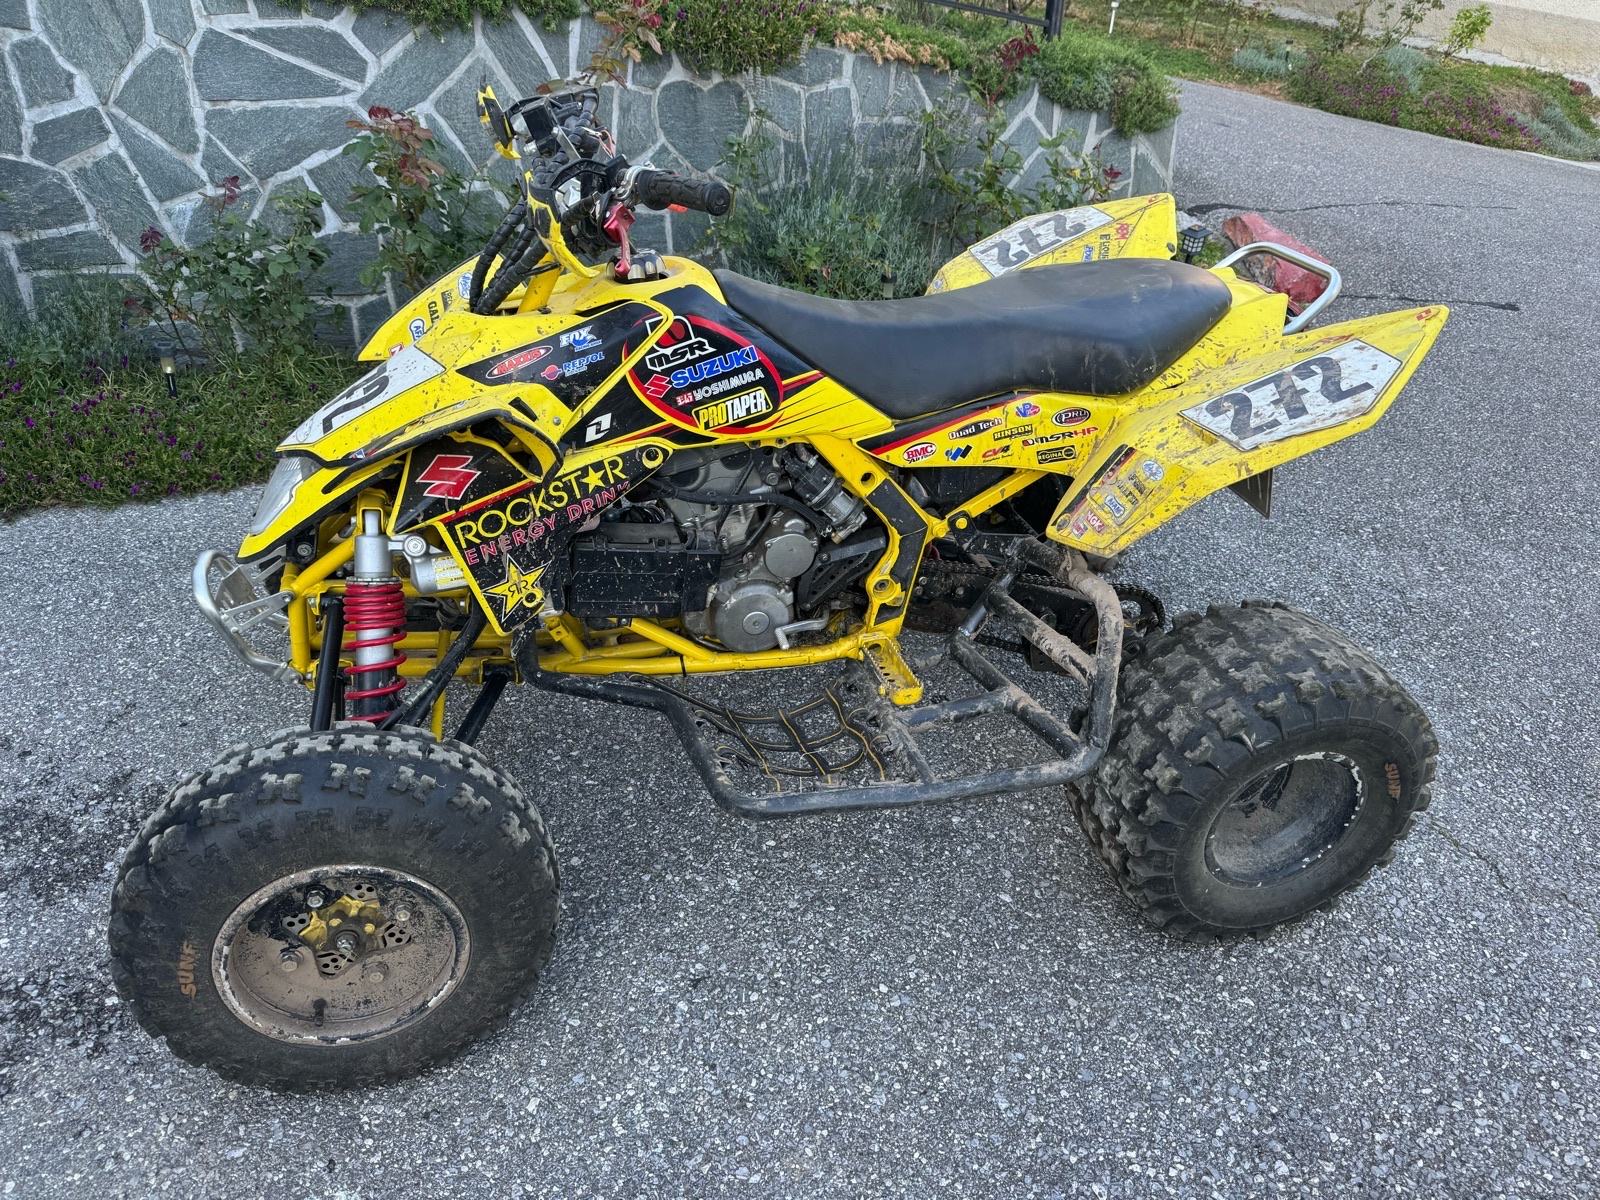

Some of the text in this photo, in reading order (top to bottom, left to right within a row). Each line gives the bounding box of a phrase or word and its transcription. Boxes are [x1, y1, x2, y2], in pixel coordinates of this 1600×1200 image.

[562, 352, 605, 371] REPSOL
[671, 345, 759, 388] SUZUKI
[693, 368, 764, 401] YOSHIMURA
[1205, 356, 1375, 440] 272
[949, 418, 1004, 440] Quad Tech
[993, 425, 1033, 440] HINSON
[907, 443, 934, 459] BMC
[1039, 451, 1063, 461] REGINA
[464, 514, 557, 565] ENERGY
